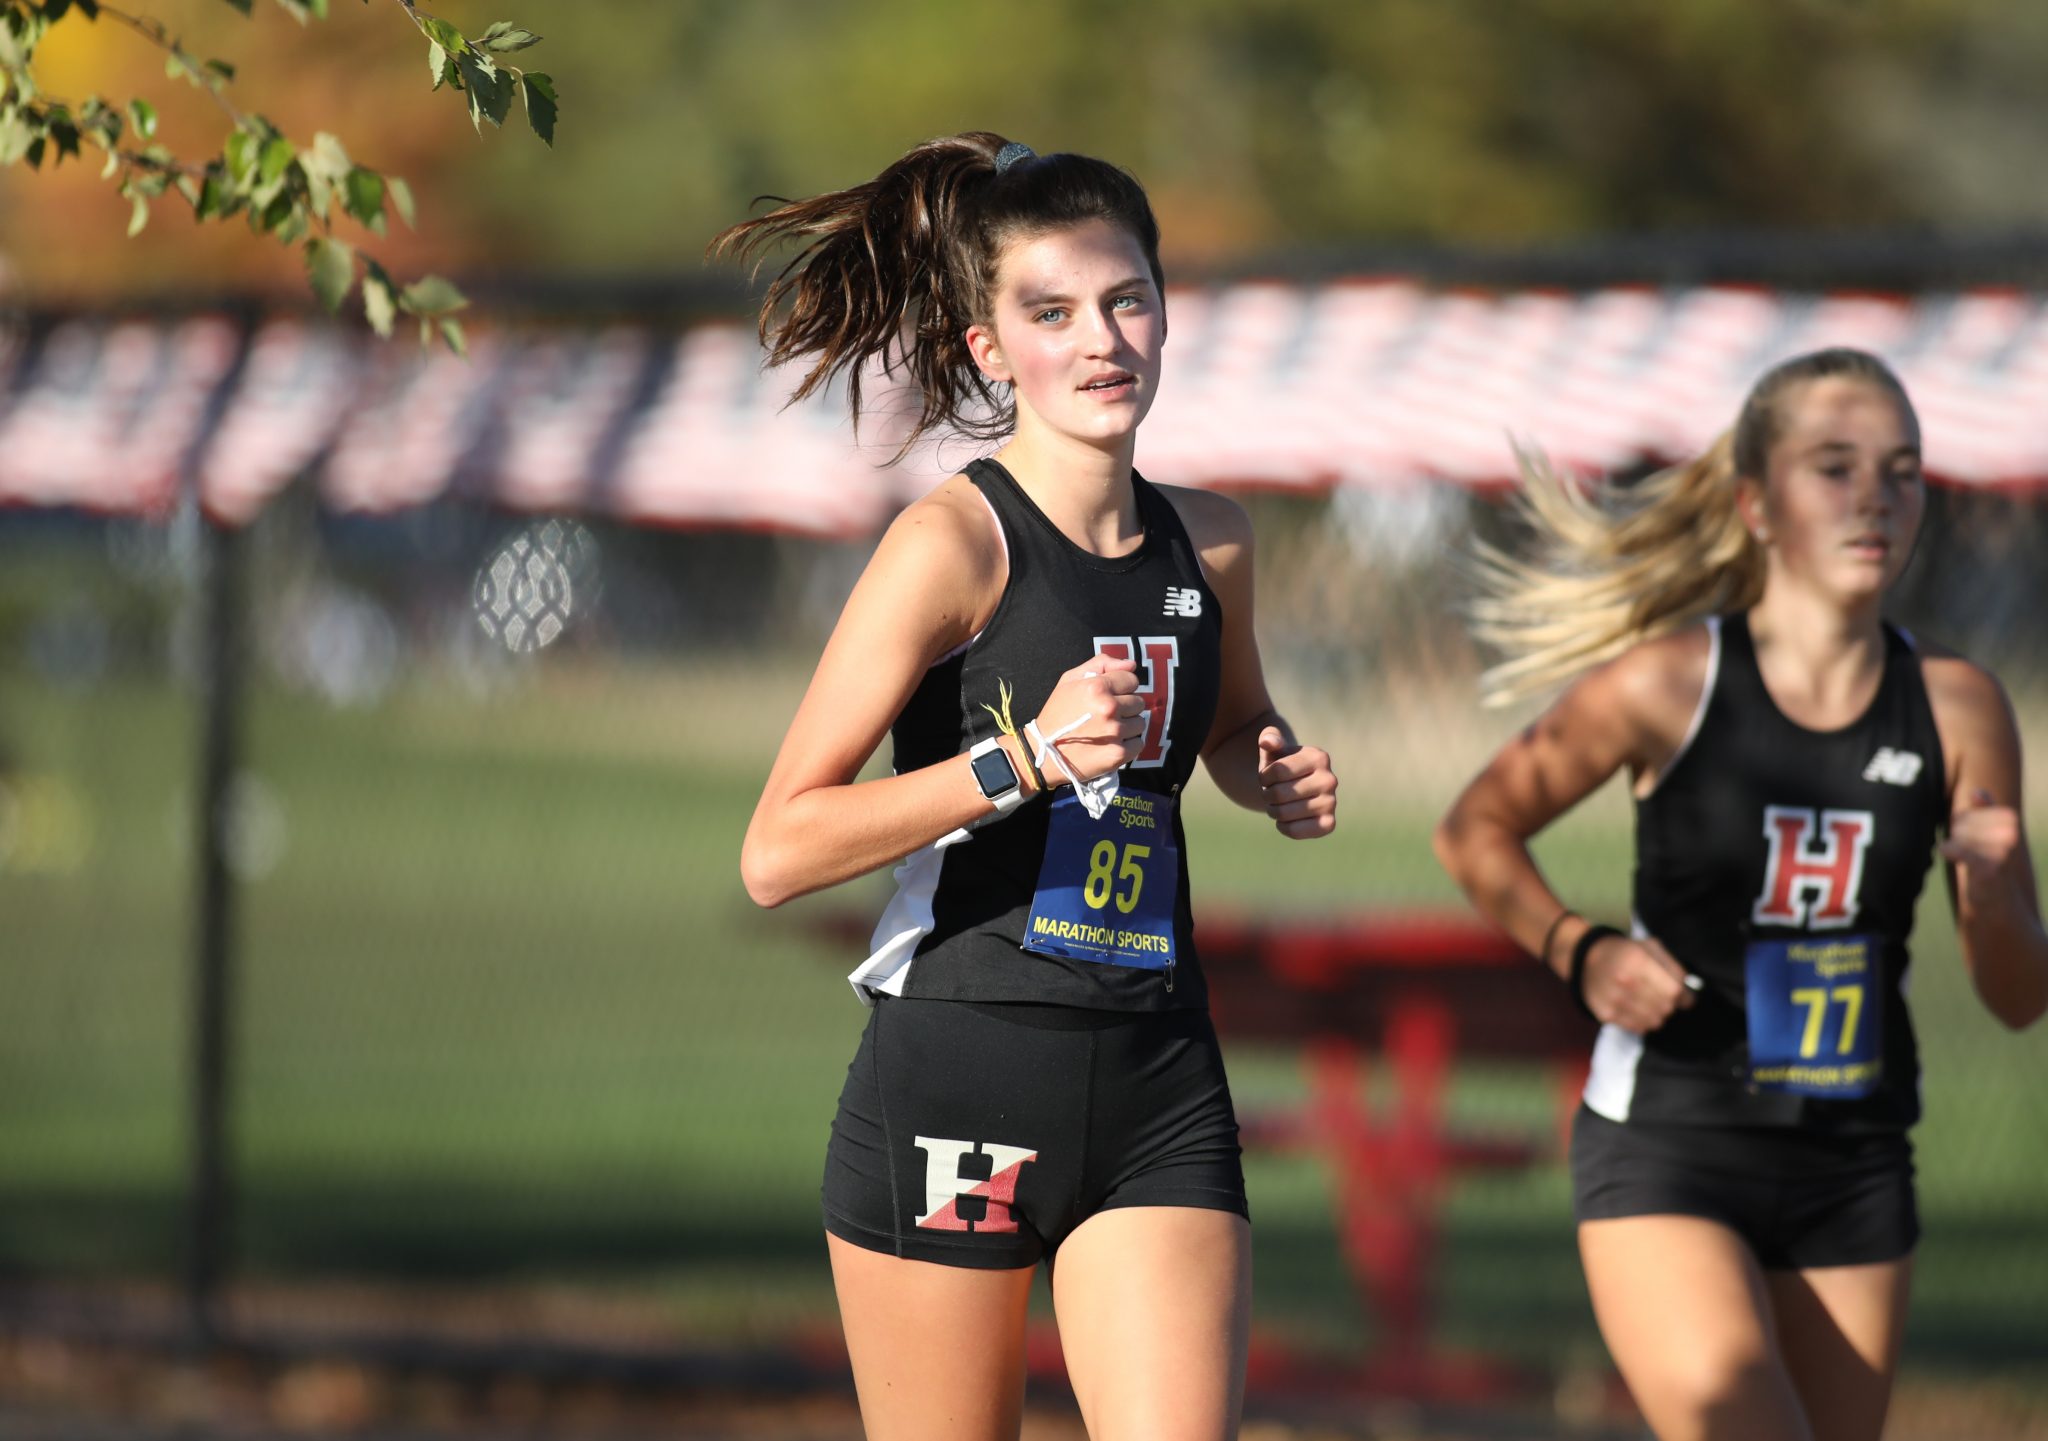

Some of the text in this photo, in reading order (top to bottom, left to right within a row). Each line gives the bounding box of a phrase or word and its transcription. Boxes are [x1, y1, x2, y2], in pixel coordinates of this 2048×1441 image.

[1111, 795, 1153, 813] arathon
[1119, 809, 1155, 829] Sports
[1084, 840, 1150, 913] 85
[1753, 804, 1873, 929] H
[1033, 916, 1114, 945] MARATHON
[1117, 930, 1169, 953] SPORTS
[1791, 985, 1863, 1058] 77
[914, 1135, 1038, 1233] H
